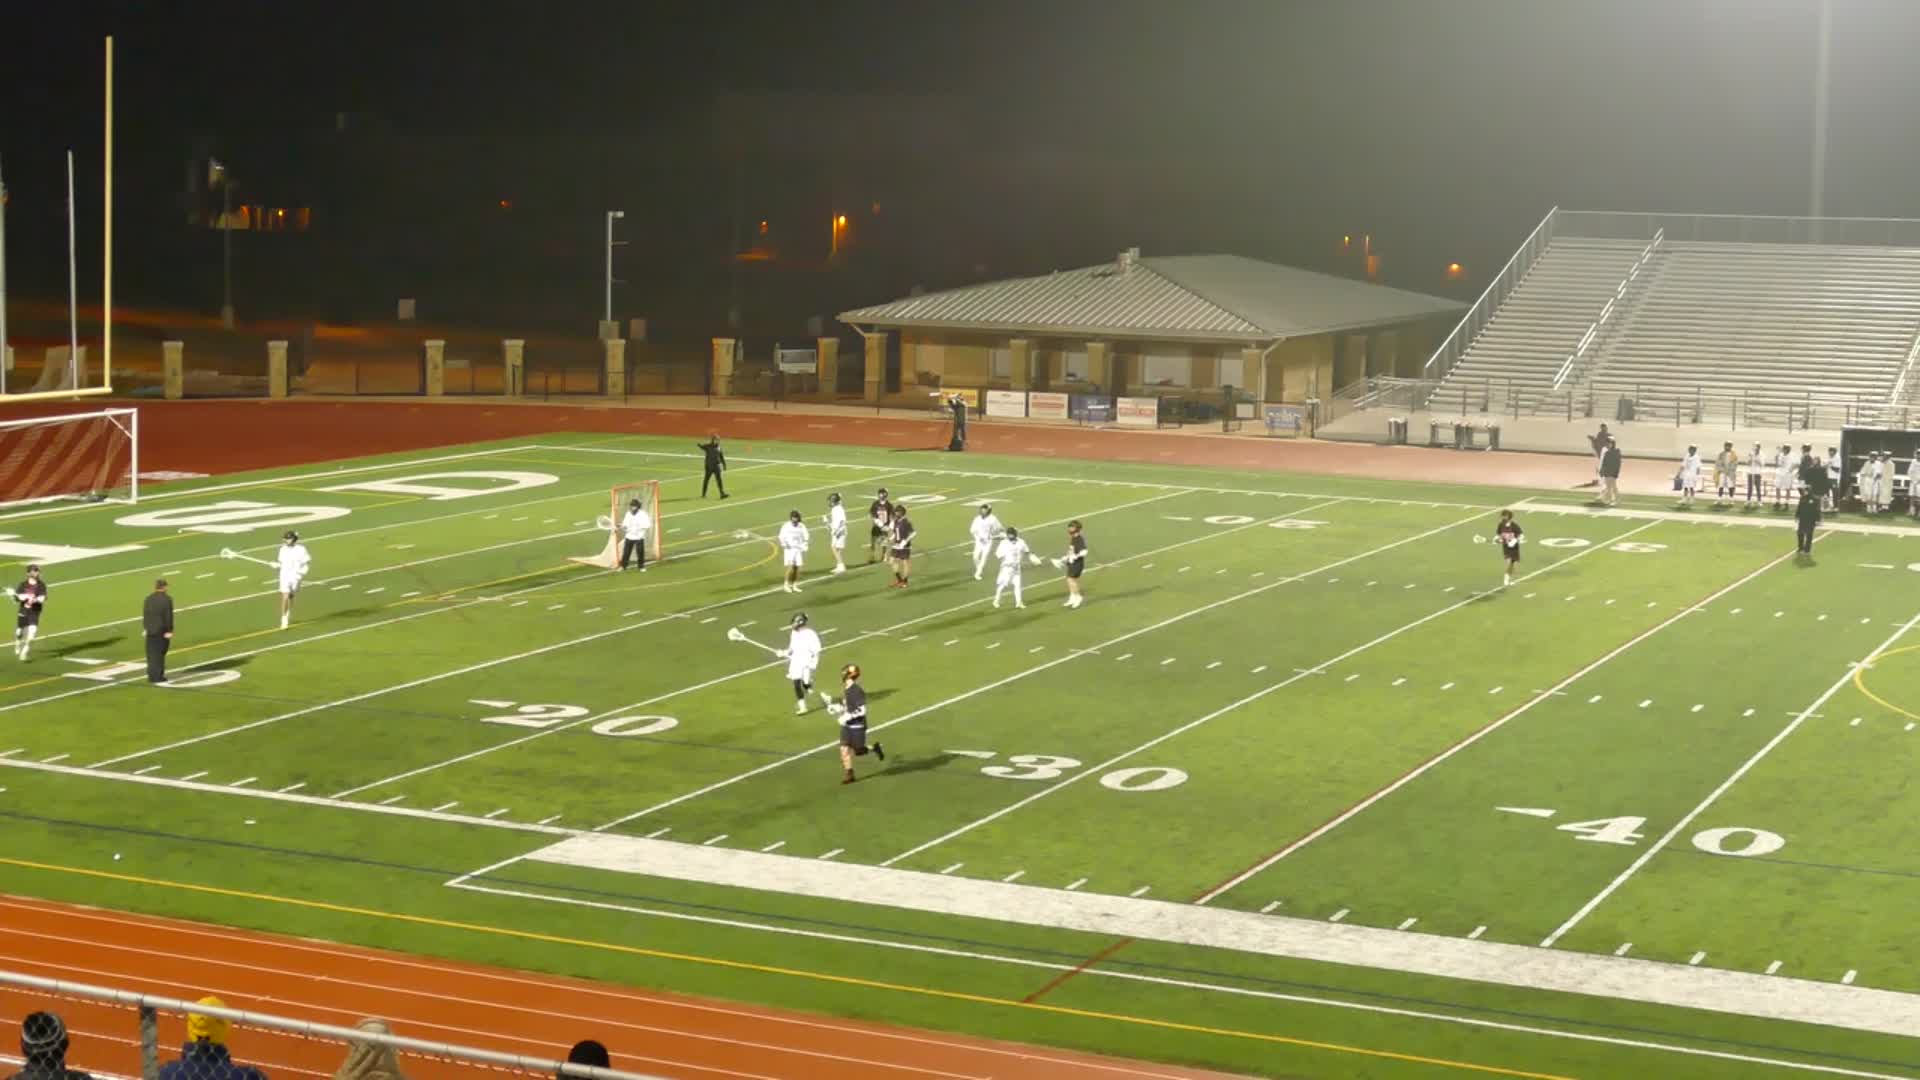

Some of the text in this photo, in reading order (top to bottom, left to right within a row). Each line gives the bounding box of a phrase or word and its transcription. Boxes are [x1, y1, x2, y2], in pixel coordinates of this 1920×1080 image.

[479, 704, 679, 736] 20
[980, 755, 1189, 791] 30
[1556, 815, 1785, 857] 40
